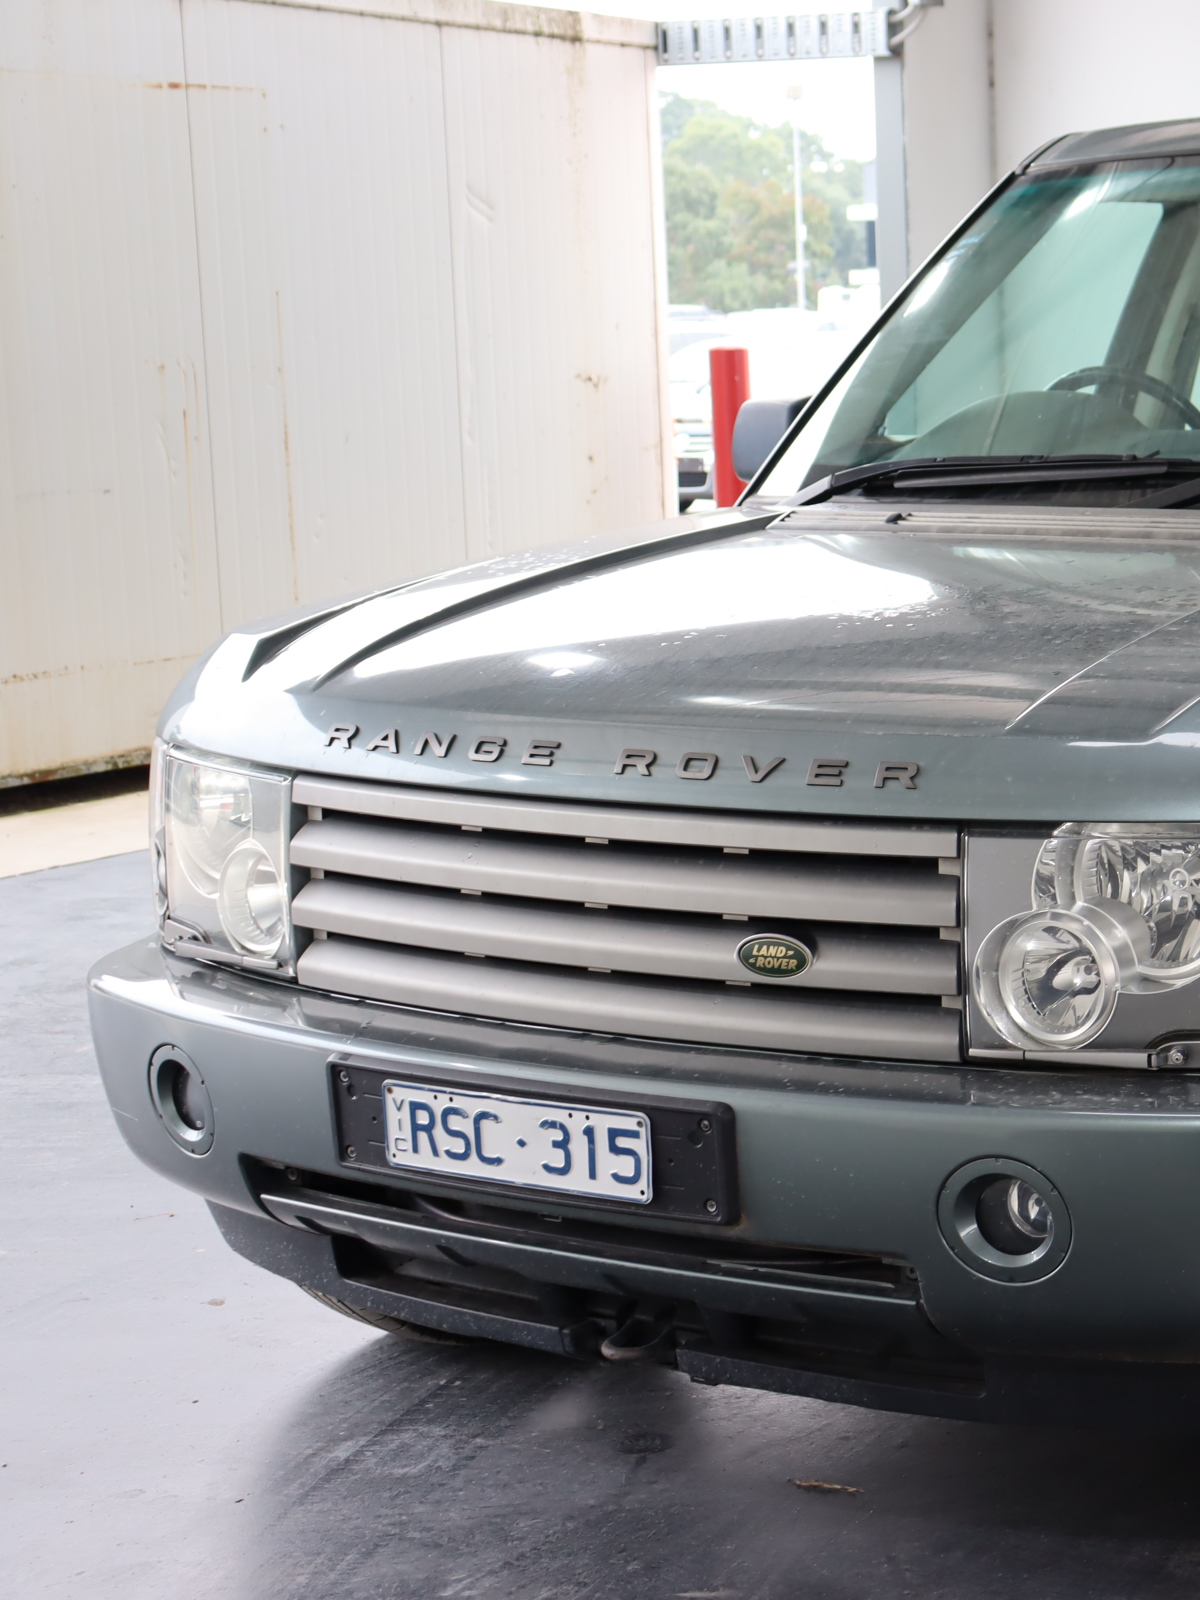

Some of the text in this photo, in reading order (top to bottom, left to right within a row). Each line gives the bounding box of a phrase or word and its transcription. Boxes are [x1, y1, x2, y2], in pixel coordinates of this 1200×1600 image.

[323, 723, 921, 790] RANGE ROVER
[752, 944, 787, 958] LAND
[755, 957, 798, 970] ROVER
[408, 1099, 643, 1185] RSC 315
